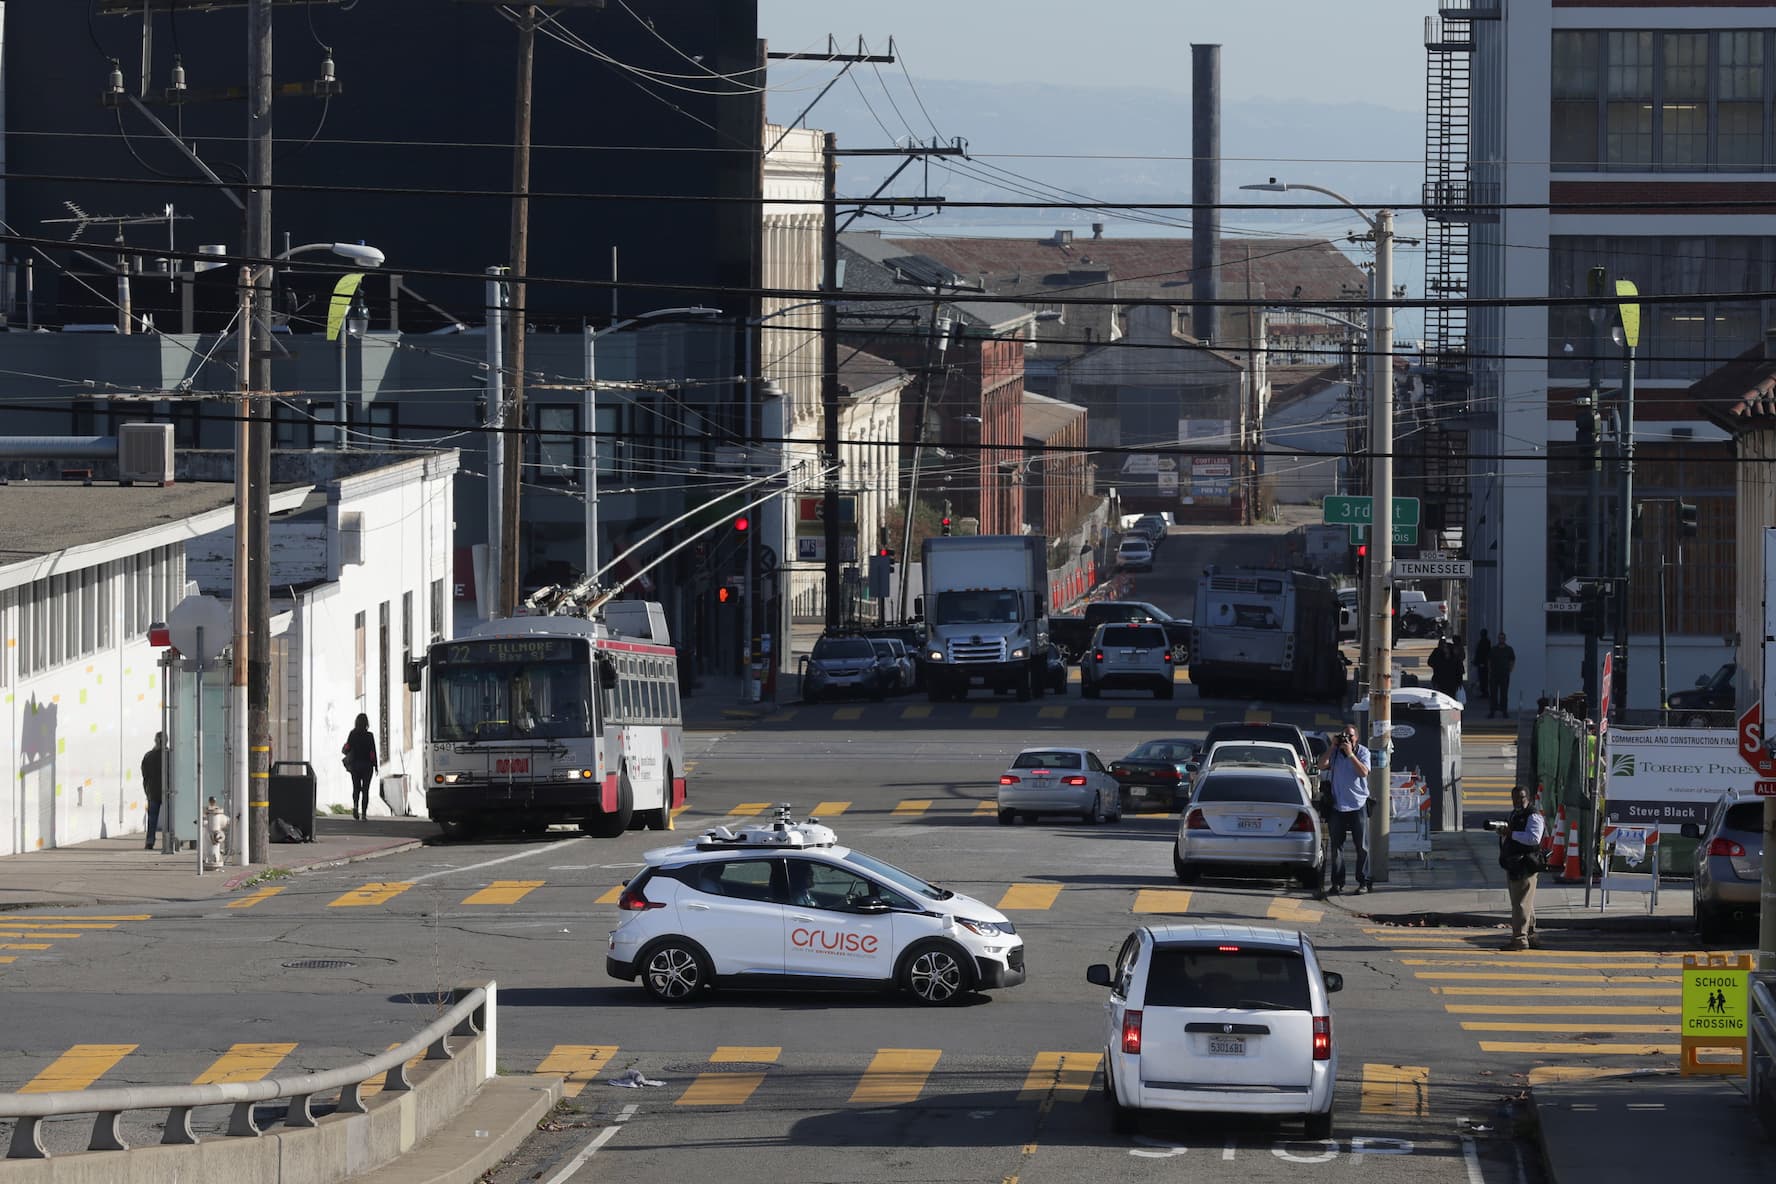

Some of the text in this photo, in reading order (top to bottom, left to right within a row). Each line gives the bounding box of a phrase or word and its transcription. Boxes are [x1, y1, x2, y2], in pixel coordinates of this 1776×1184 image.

[1341, 503, 1370, 518] 3rd
[1392, 533, 1409, 542] OIS
[1401, 563, 1466, 574] TENNESSEE
[450, 642, 553, 663] 22 FILLMORE
[1611, 735, 1653, 744] COMMERCIAL
[1654, 735, 1669, 744] AND
[1671, 736, 1719, 745] CONSTRUCTION
[1640, 761, 1704, 774] TORREY
[1629, 806, 1660, 817] Steve
[1664, 806, 1695, 817] Black
[791, 928, 878, 953] cruise
[1695, 977, 1738, 987] SCHOOL
[1689, 1019, 1743, 1029] CROSSING
